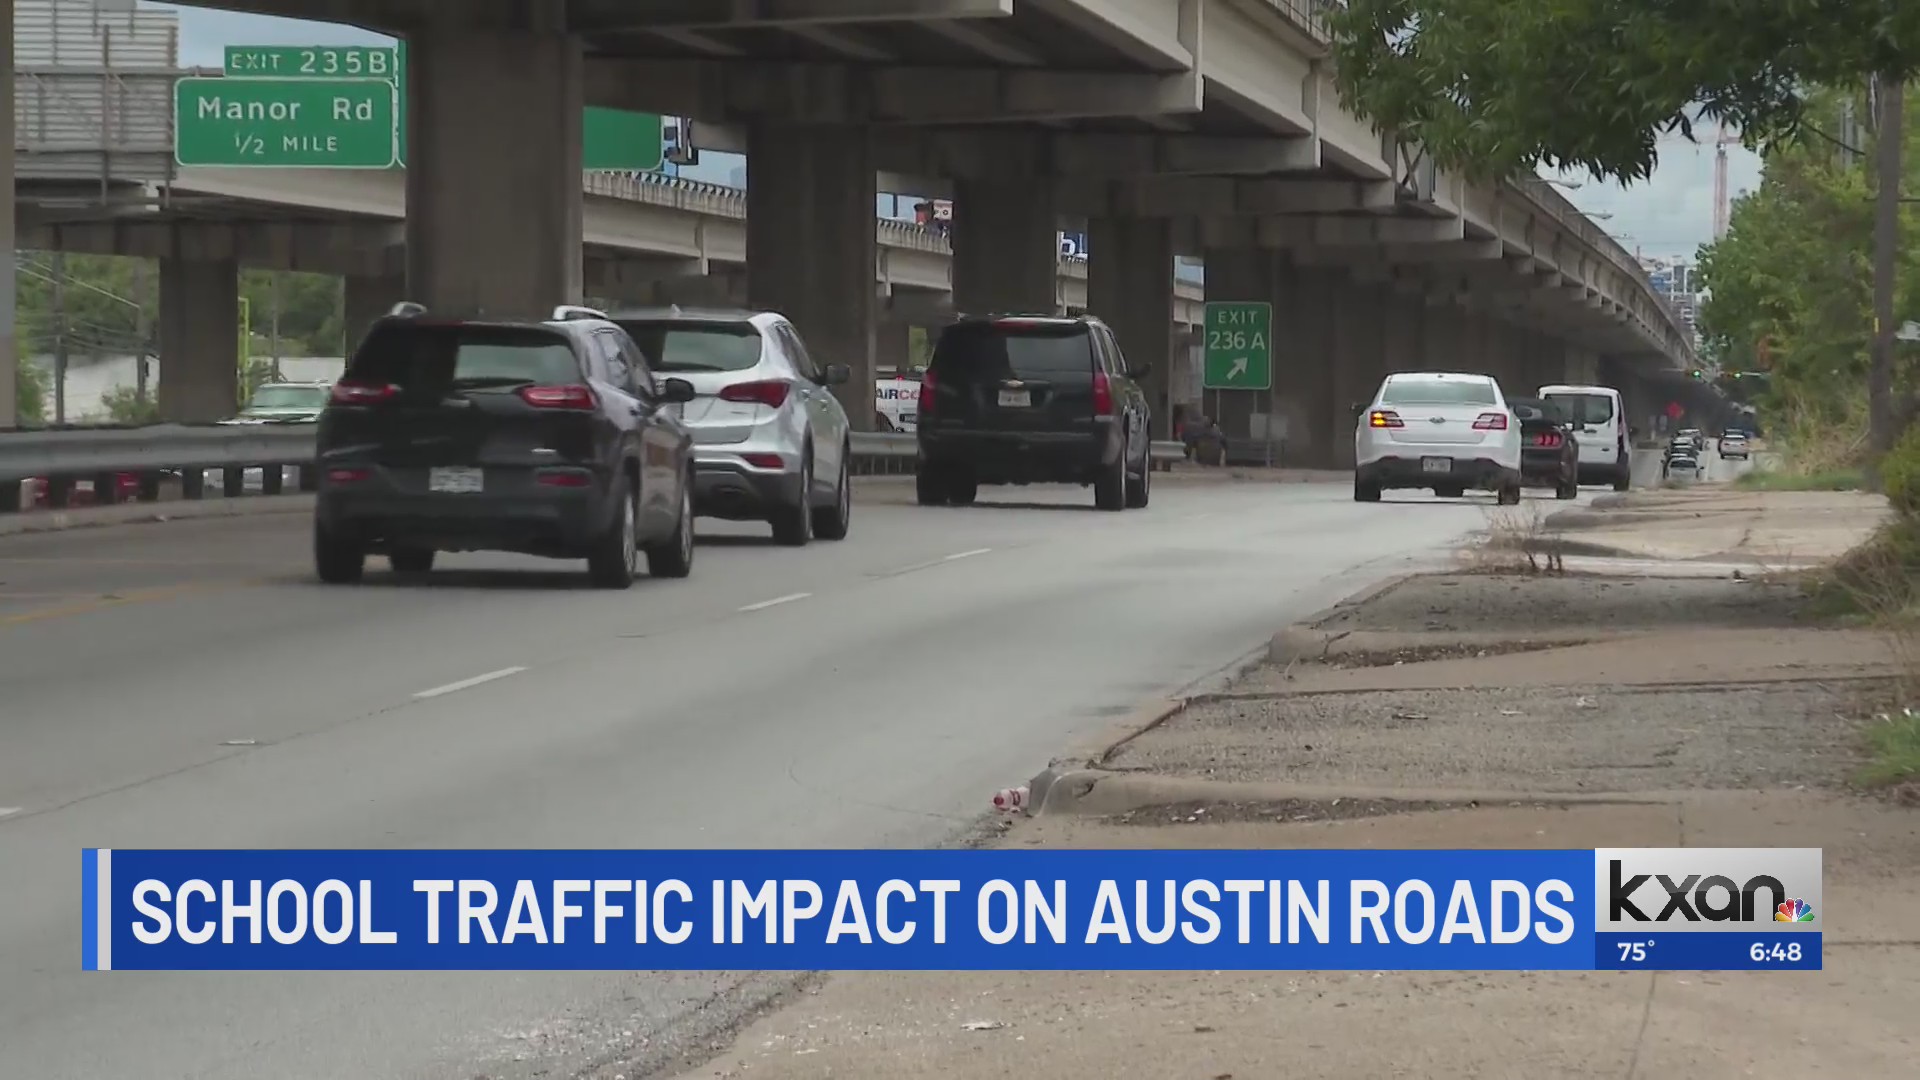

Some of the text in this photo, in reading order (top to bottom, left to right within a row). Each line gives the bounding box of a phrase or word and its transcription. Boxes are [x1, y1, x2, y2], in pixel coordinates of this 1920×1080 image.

[230, 51, 387, 74] EXIT 235B
[198, 96, 373, 121] Manor Rd
[282, 136, 338, 152] MILE
[1218, 311, 1258, 324] EXIT
[1209, 331, 1265, 350] 236 A
